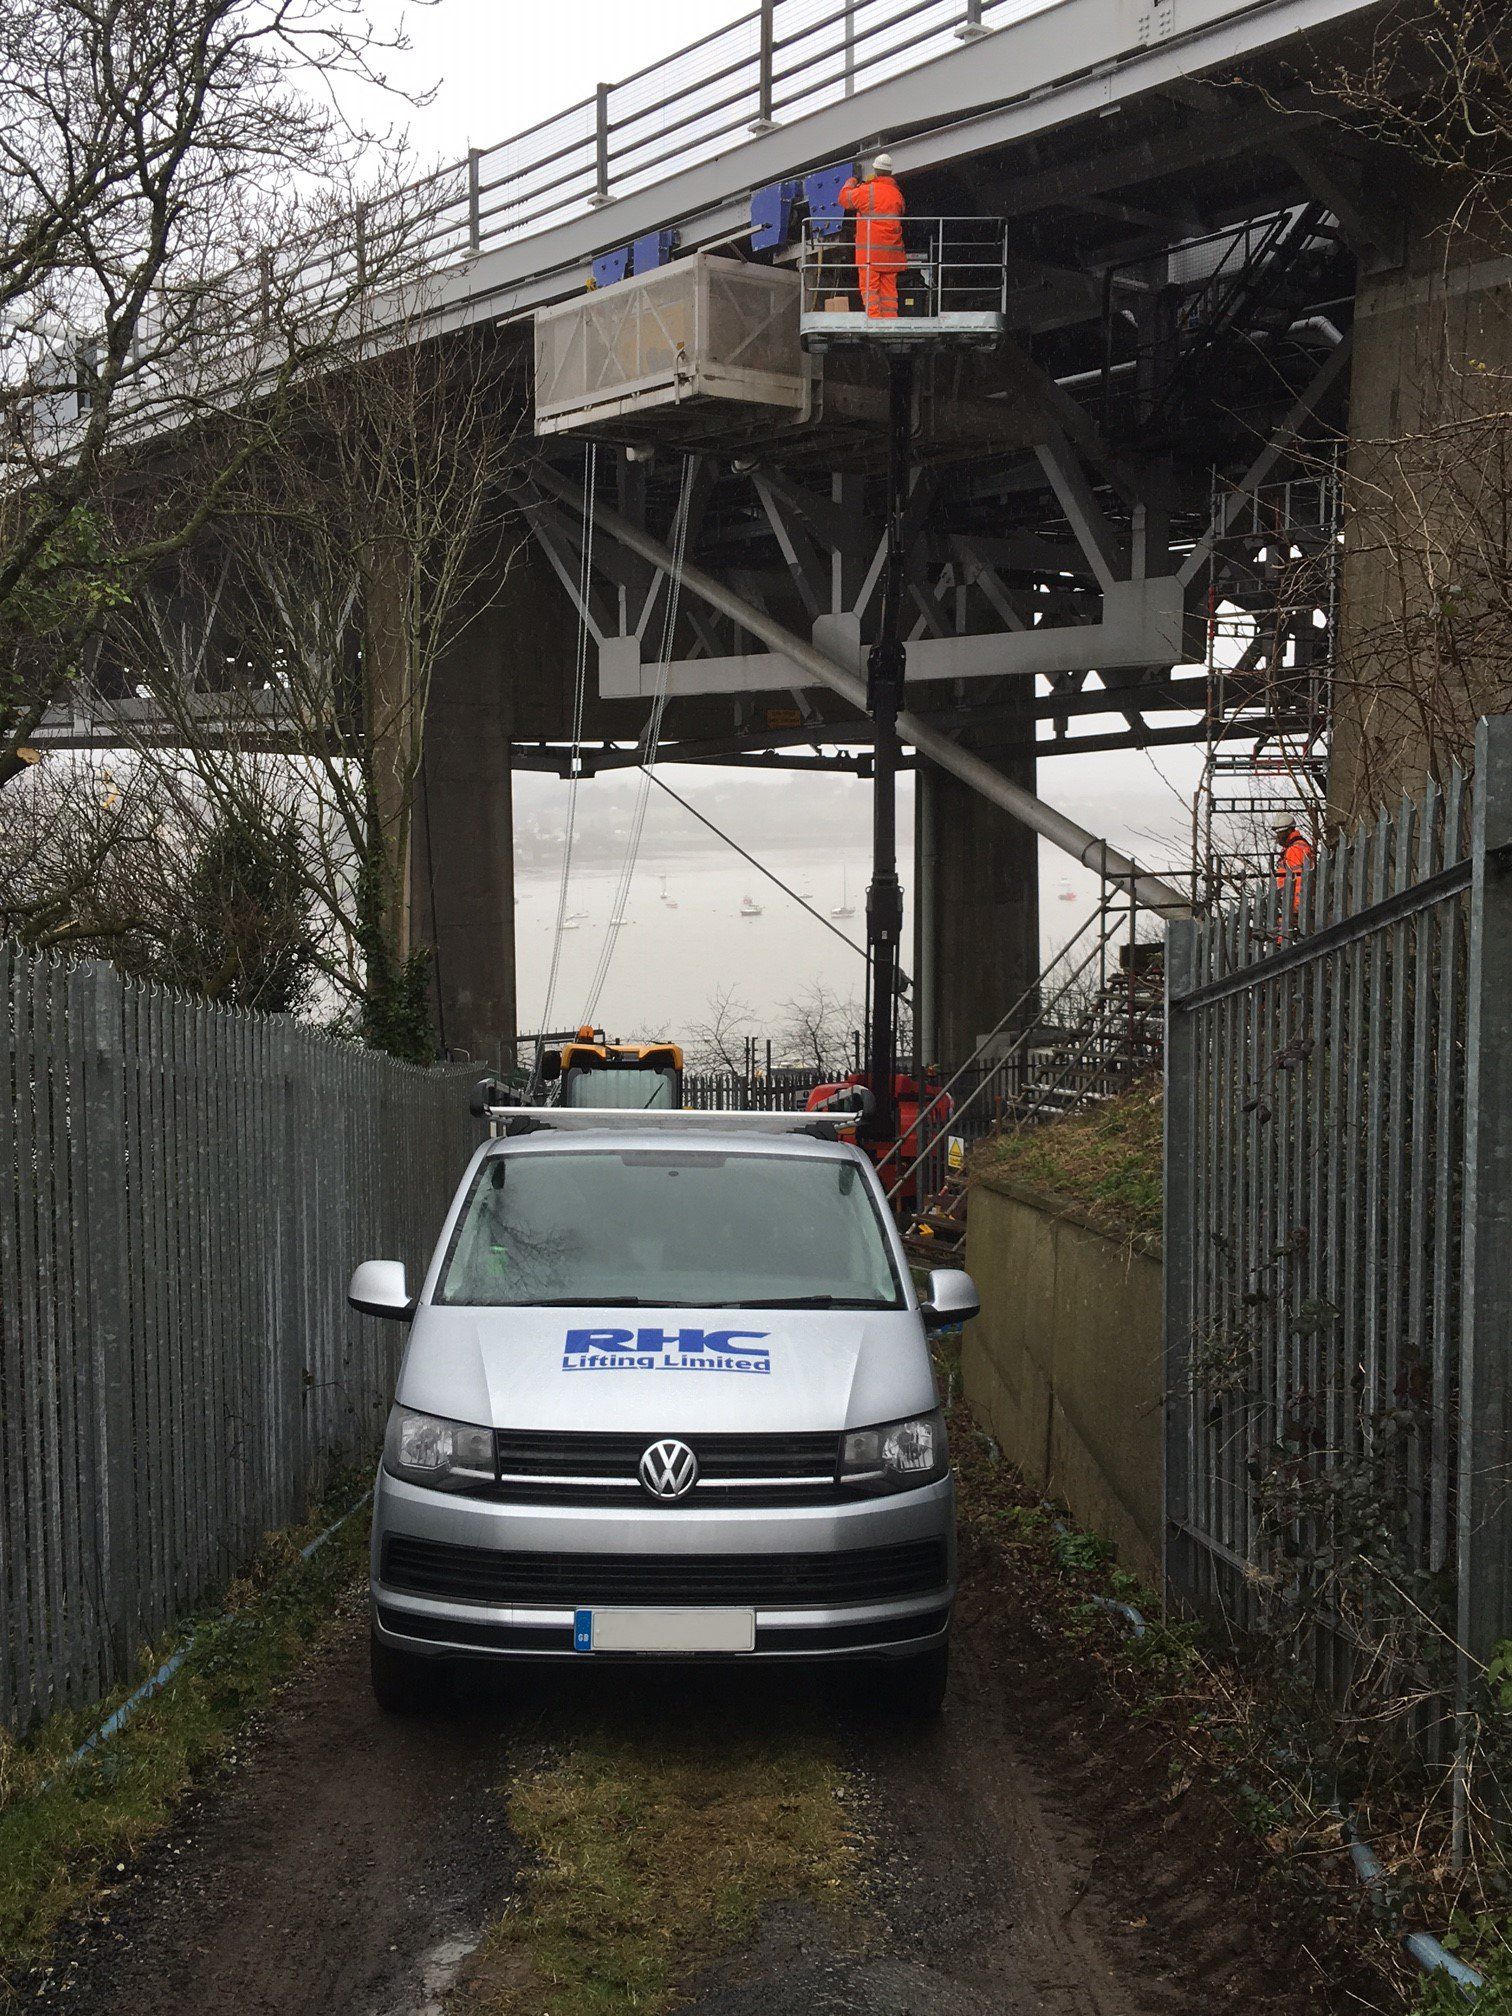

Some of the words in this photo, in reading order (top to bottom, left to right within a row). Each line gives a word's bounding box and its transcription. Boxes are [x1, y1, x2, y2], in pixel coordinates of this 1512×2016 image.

[564, 1328, 771, 1356] RHC
[562, 1354, 654, 1369] Lifting
[664, 1354, 770, 1371] Limited
[578, 1633, 589, 1642] GB
